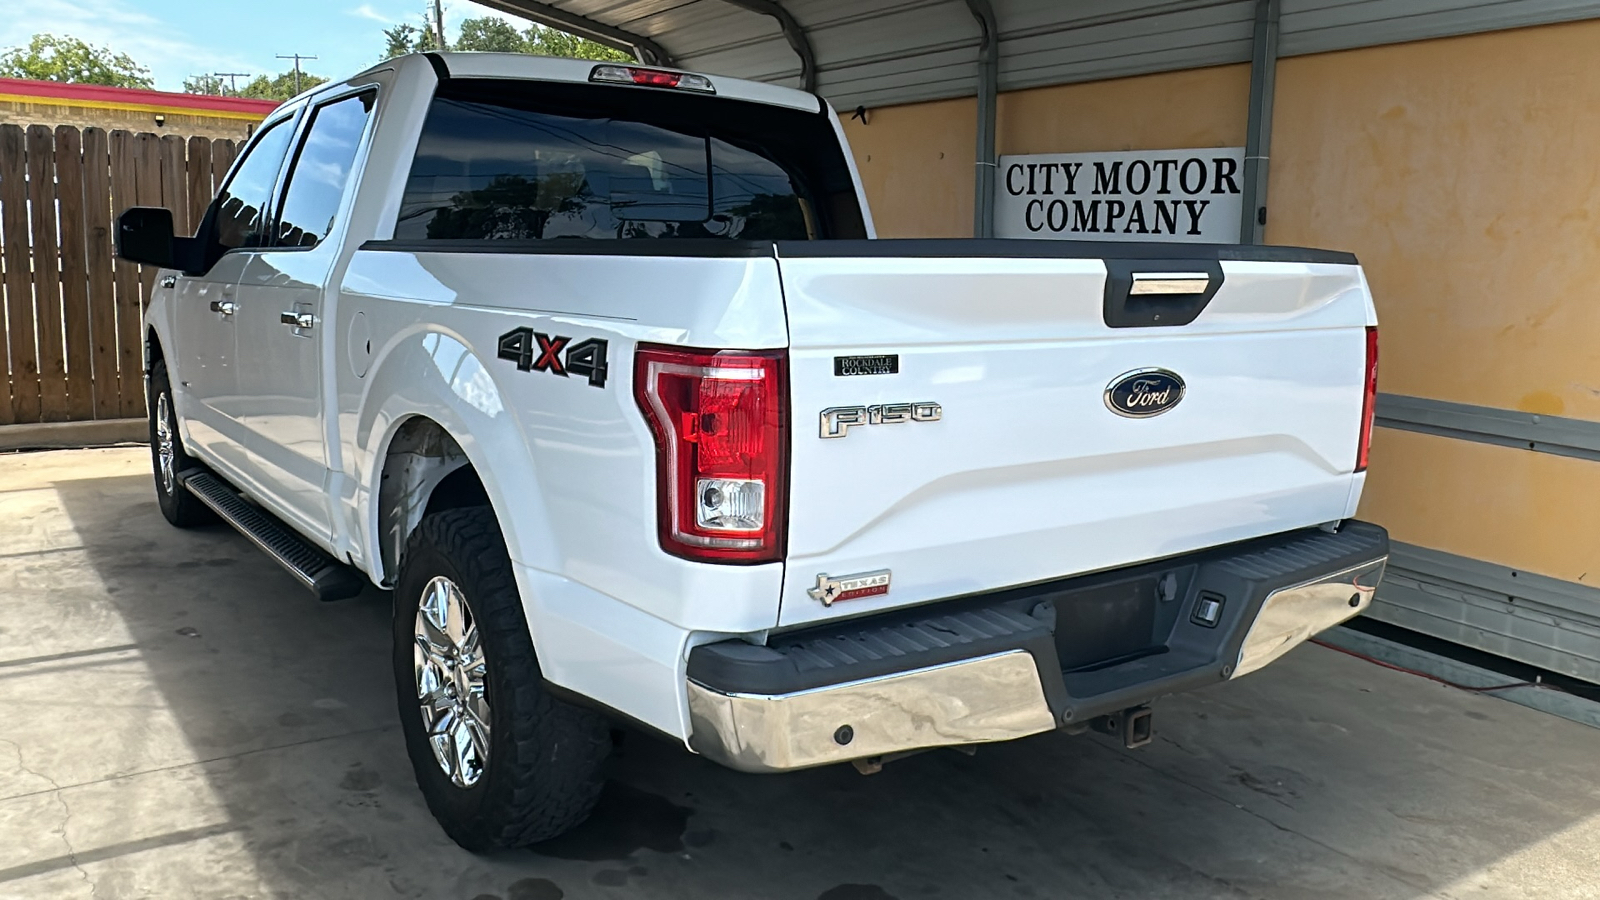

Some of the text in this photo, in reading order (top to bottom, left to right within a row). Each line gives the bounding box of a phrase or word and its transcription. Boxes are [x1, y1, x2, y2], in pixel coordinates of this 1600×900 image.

[1005, 157, 1241, 196] CITY MOTOR
[1025, 199, 1210, 235] COMPANY
[841, 358, 892, 368] ROCKDALE
[841, 366, 892, 376] COUNTRY
[1126, 379, 1172, 408] Ford
[841, 576, 887, 589] TEXAS
[841, 586, 885, 598] EDITION
